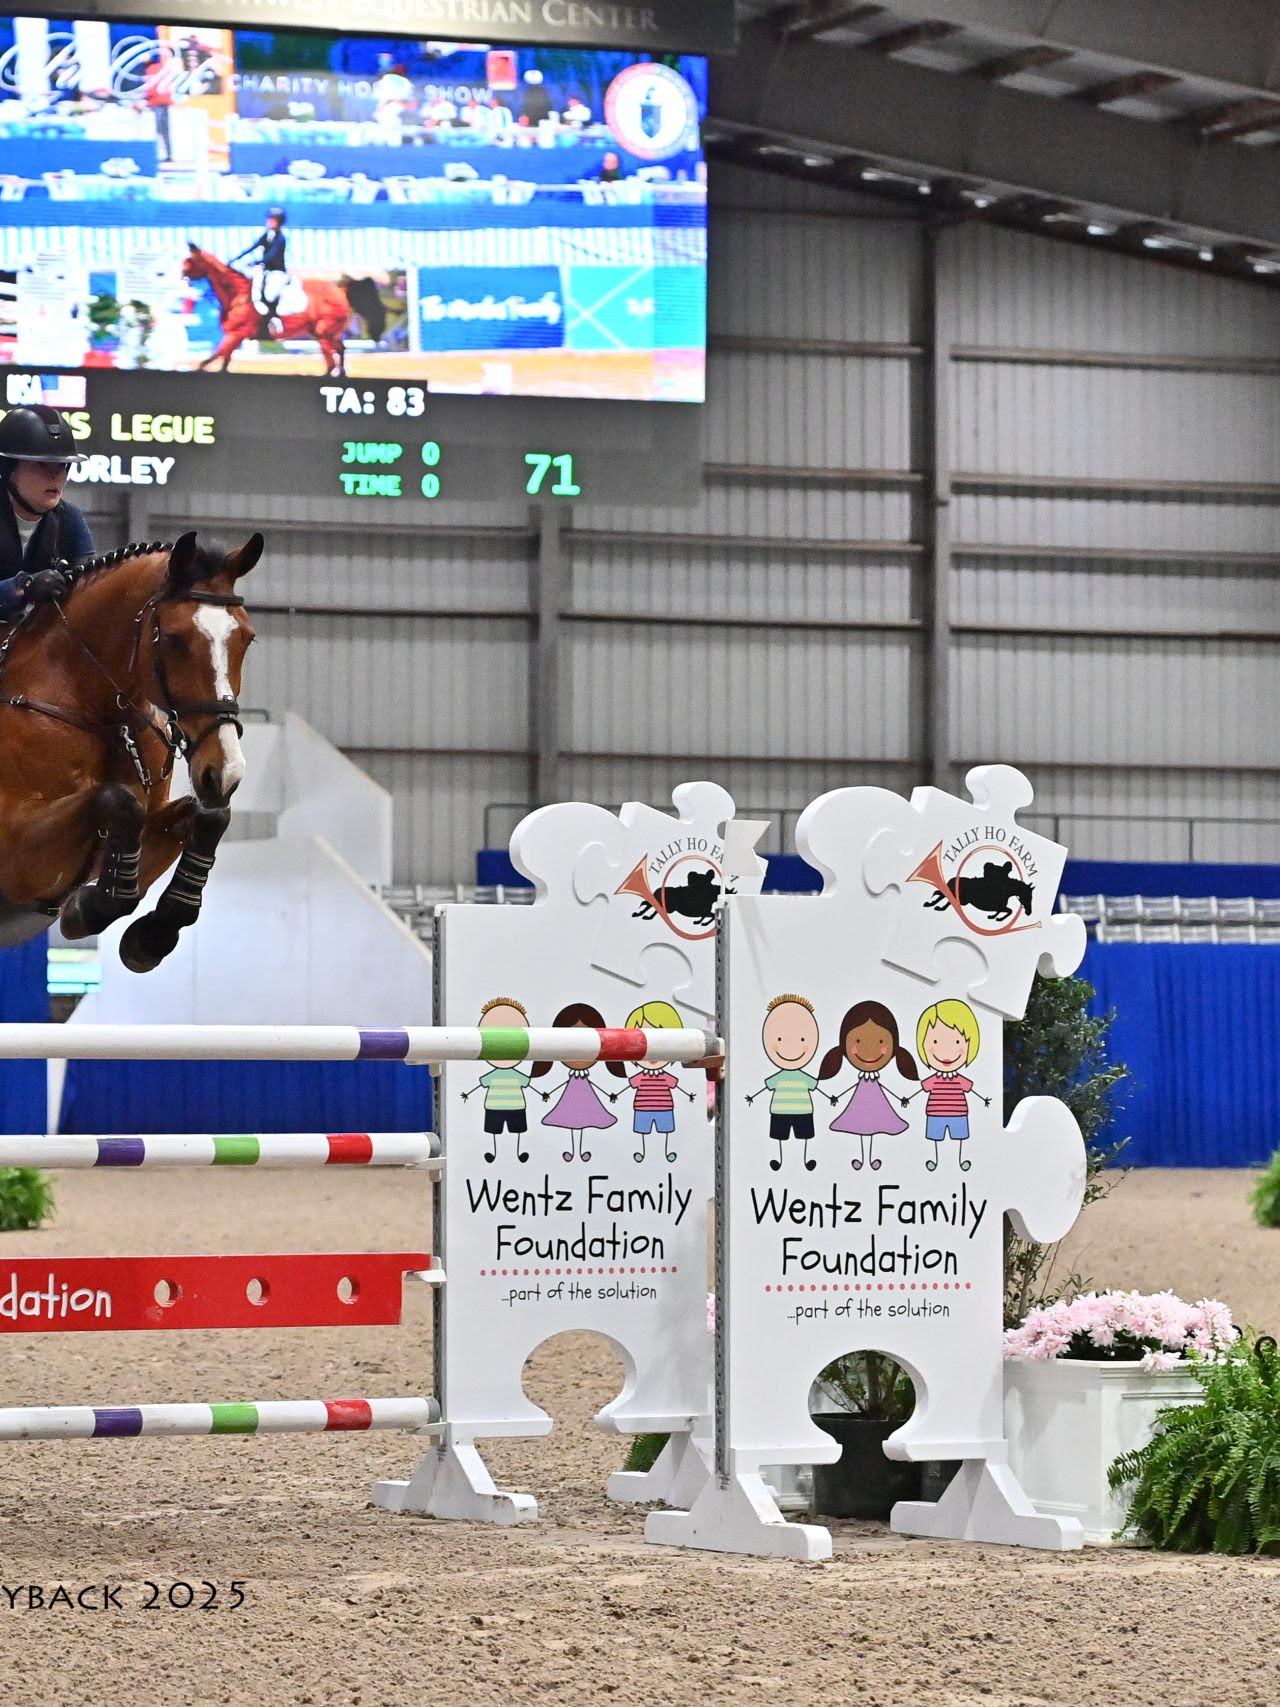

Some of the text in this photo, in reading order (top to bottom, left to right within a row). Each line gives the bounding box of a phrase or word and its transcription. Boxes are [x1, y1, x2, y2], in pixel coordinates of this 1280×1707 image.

[541, 0, 658, 30] CENTER
[227, 74, 330, 95] CHARITY
[6, 373, 43, 405] USA
[320, 386, 425, 417] TA: 83
[111, 413, 217, 444] LEGUE
[341, 441, 441, 466] JUMP 0
[66, 454, 176, 485] ORLEY
[524, 453, 581, 496] 71
[339, 473, 441, 498] TIME 0
[648, 838, 683, 874] TALLY
[686, 837, 708, 852] HO
[942, 825, 1040, 878] TALLY HO FARM
[466, 1173, 693, 1226] Wentz Family
[751, 1182, 988, 1240] Wentz Family
[496, 1222, 664, 1262] Foundation
[782, 1234, 958, 1277] Foundation
[546, 1282, 564, 1300] of
[568, 1282, 593, 1300] the
[598, 1281, 657, 1300] solution
[834, 1298, 853, 1319] of
[857, 1299, 883, 1319] the
[888, 1299, 950, 1318] solution
